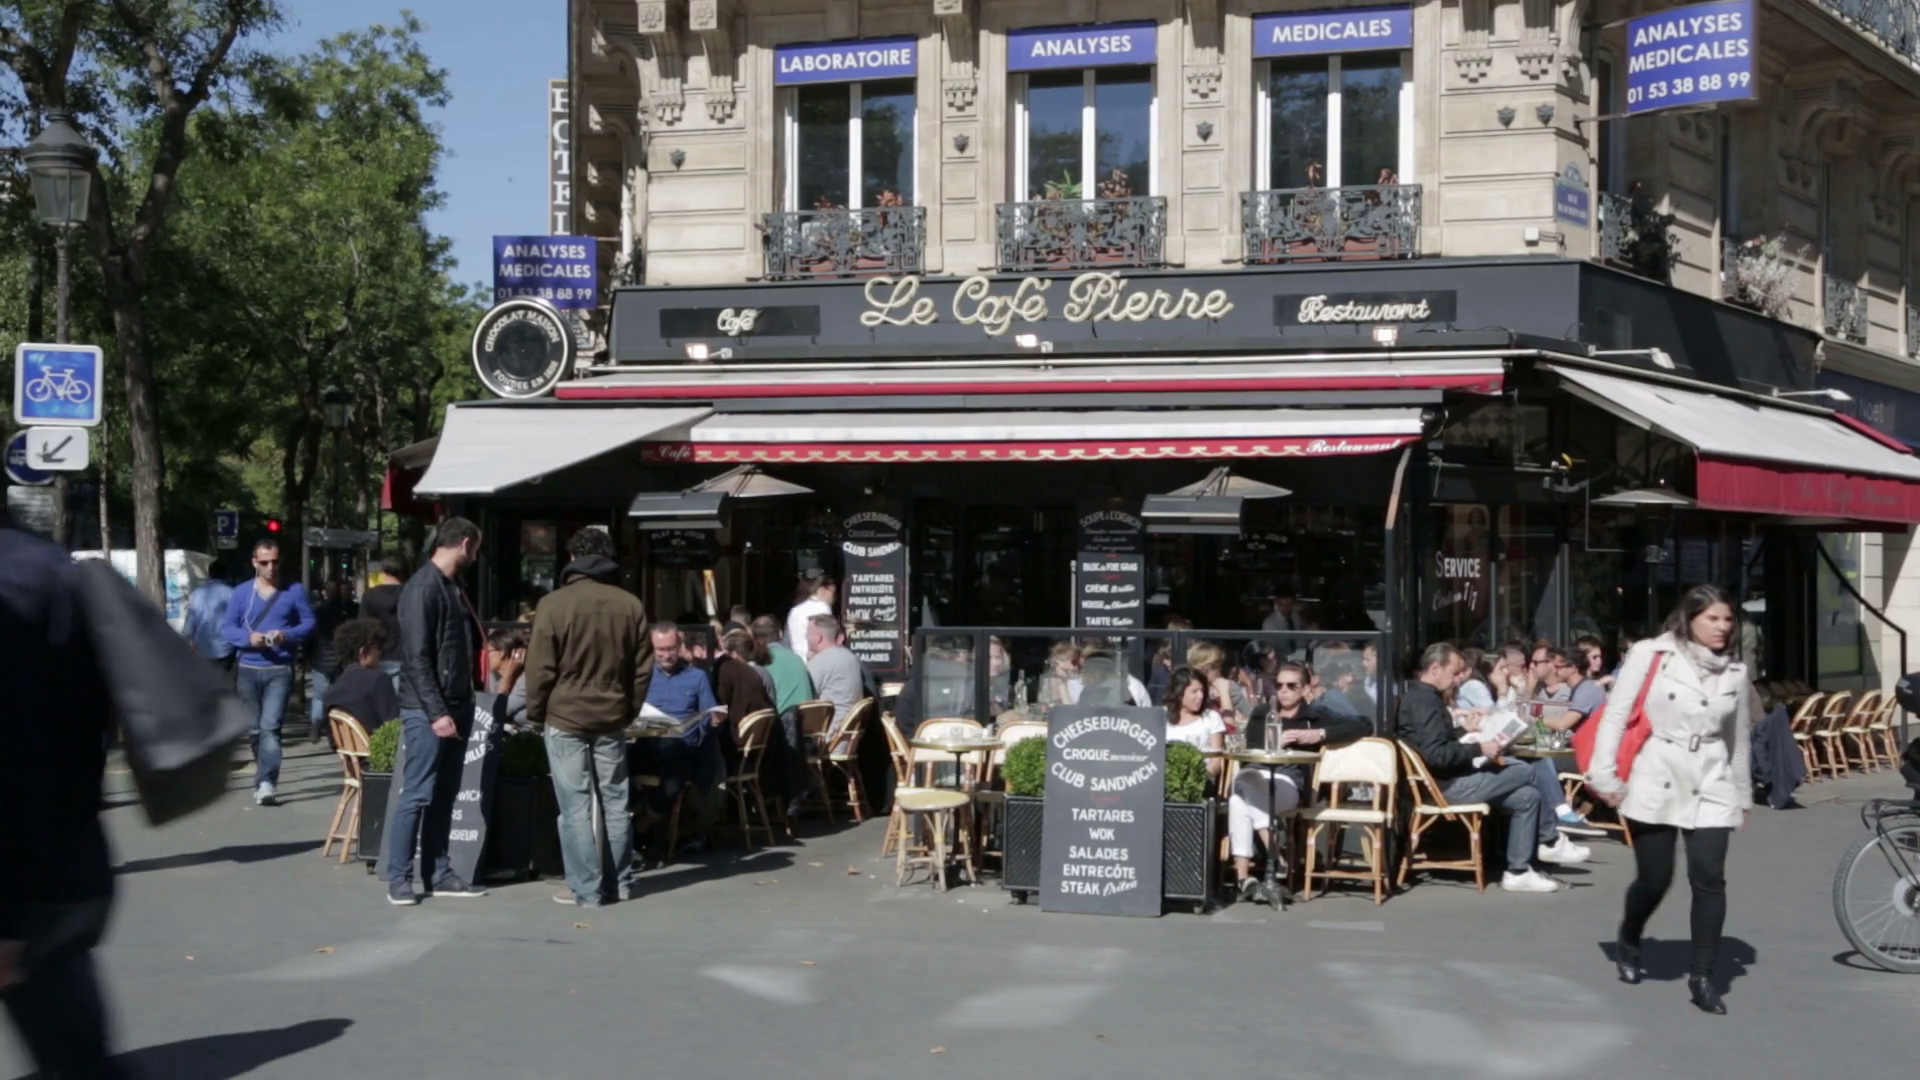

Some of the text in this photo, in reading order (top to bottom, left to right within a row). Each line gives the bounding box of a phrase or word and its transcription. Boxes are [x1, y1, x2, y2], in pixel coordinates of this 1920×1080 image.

[1272, 18, 1392, 43] MEDICALES
[1633, 12, 1742, 47] ANALYSES
[1031, 35, 1132, 58] ANALYSES
[780, 47, 911, 74] LABORATOIRE
[1629, 38, 1749, 74] MEDICALES
[1627, 71, 1751, 104] 01 53 38 88 99
[503, 245, 586, 259] ANALYSES
[498, 264, 591, 278] MEDICALES
[498, 288, 512, 300] 01
[537, 288, 554, 300] 38
[556, 288, 573, 300] 88
[576, 288, 592, 300] 99
[860, 271, 1234, 335] Le Café Pierre
[1297, 294, 1431, 323] Restaurant
[716, 308, 758, 335] Café
[484, 310, 560, 352] CHOCOLAT MAISON
[530, 375, 545, 388] EN
[1306, 439, 1402, 453] Restaurant
[843, 541, 866, 557] CLUB
[1435, 550, 1481, 578] SERVICE
[851, 573, 895, 583] TARTARES
[848, 596, 878, 605] POULET
[1085, 616, 1111, 626] TARTE
[1052, 716, 1157, 751] CHEESEBURGER
[1062, 748, 1110, 762] CROQUE
[1051, 762, 1158, 792] CLUB SANDWICH
[1071, 808, 1135, 823] TARTARES
[1089, 827, 1115, 841] WOK
[1069, 846, 1129, 861] SALADES
[1063, 863, 1136, 880] ENTRECÔTE
[1060, 880, 1100, 895] STEAK
